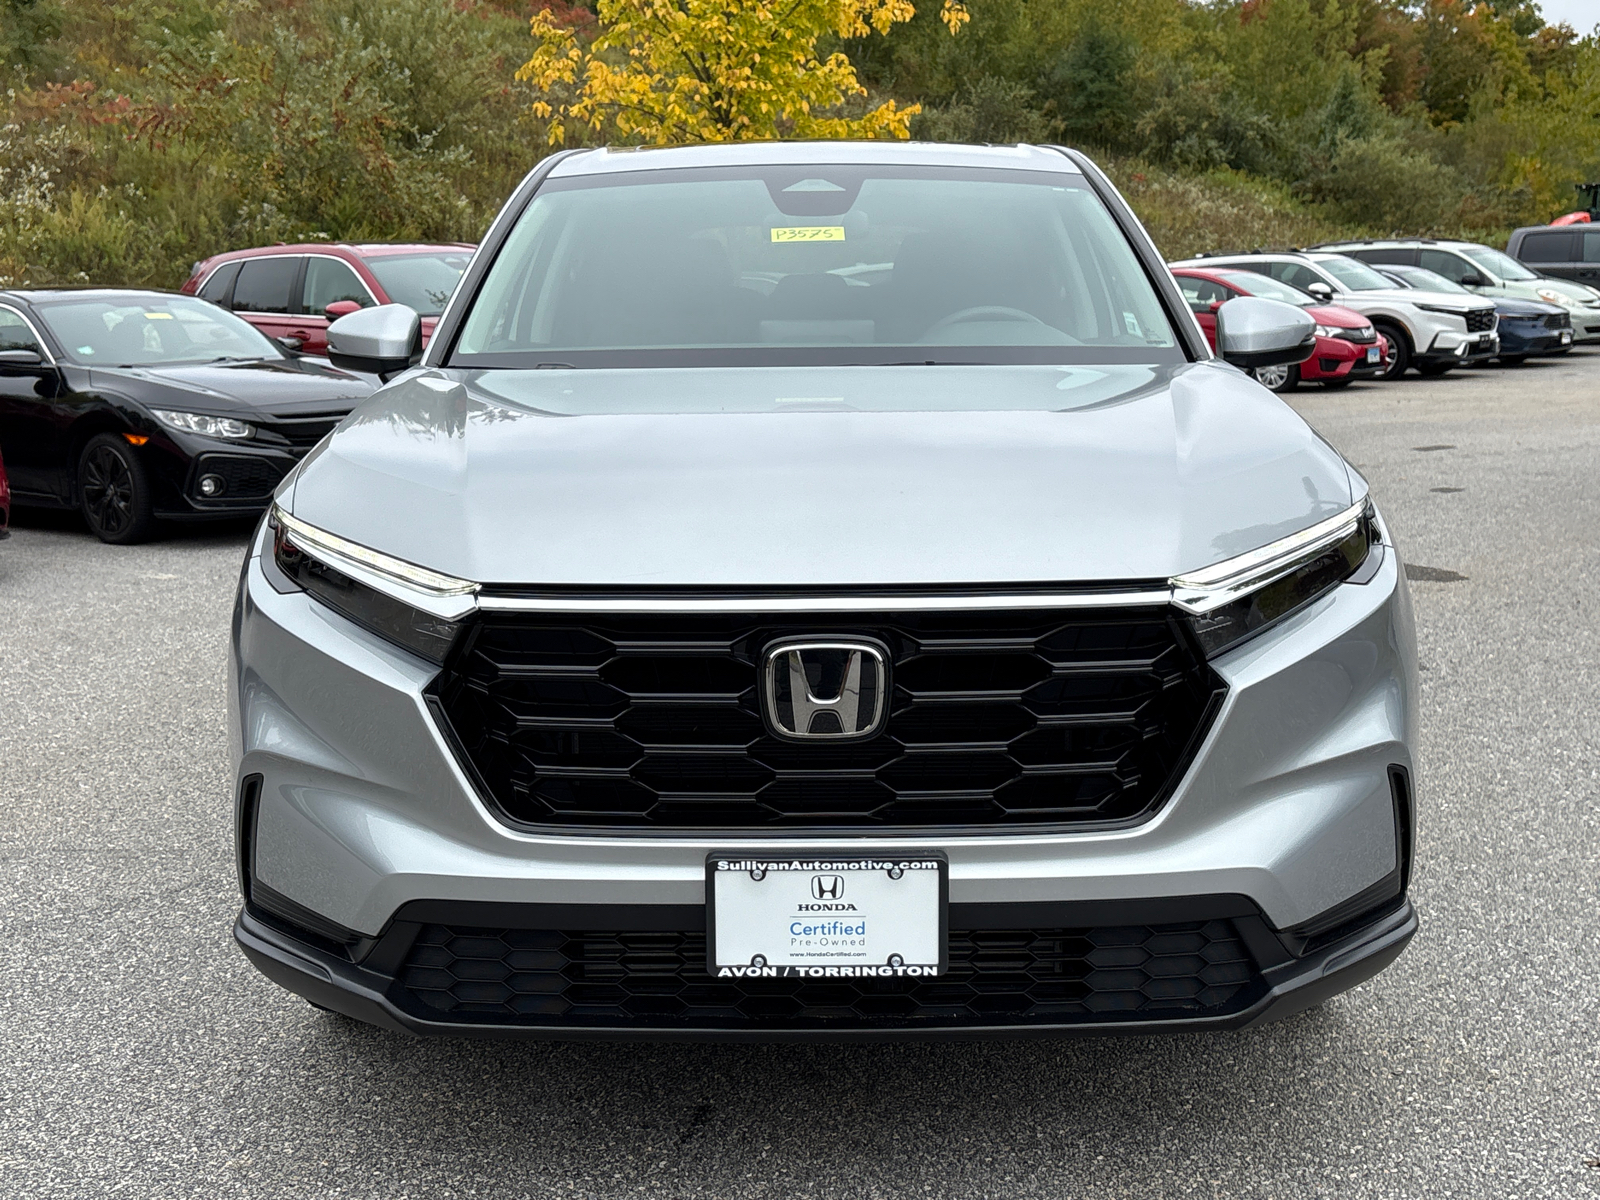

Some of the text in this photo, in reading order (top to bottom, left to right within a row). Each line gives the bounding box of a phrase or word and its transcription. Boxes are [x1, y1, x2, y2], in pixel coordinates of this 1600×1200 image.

[717, 860, 938, 871] SullivanAutomotive.com
[797, 904, 858, 912] HONDA
[790, 921, 866, 936] Certified
[790, 937, 866, 947] Pre-Owned
[717, 967, 777, 977] AVON
[795, 966, 938, 977] TORRINGTON
